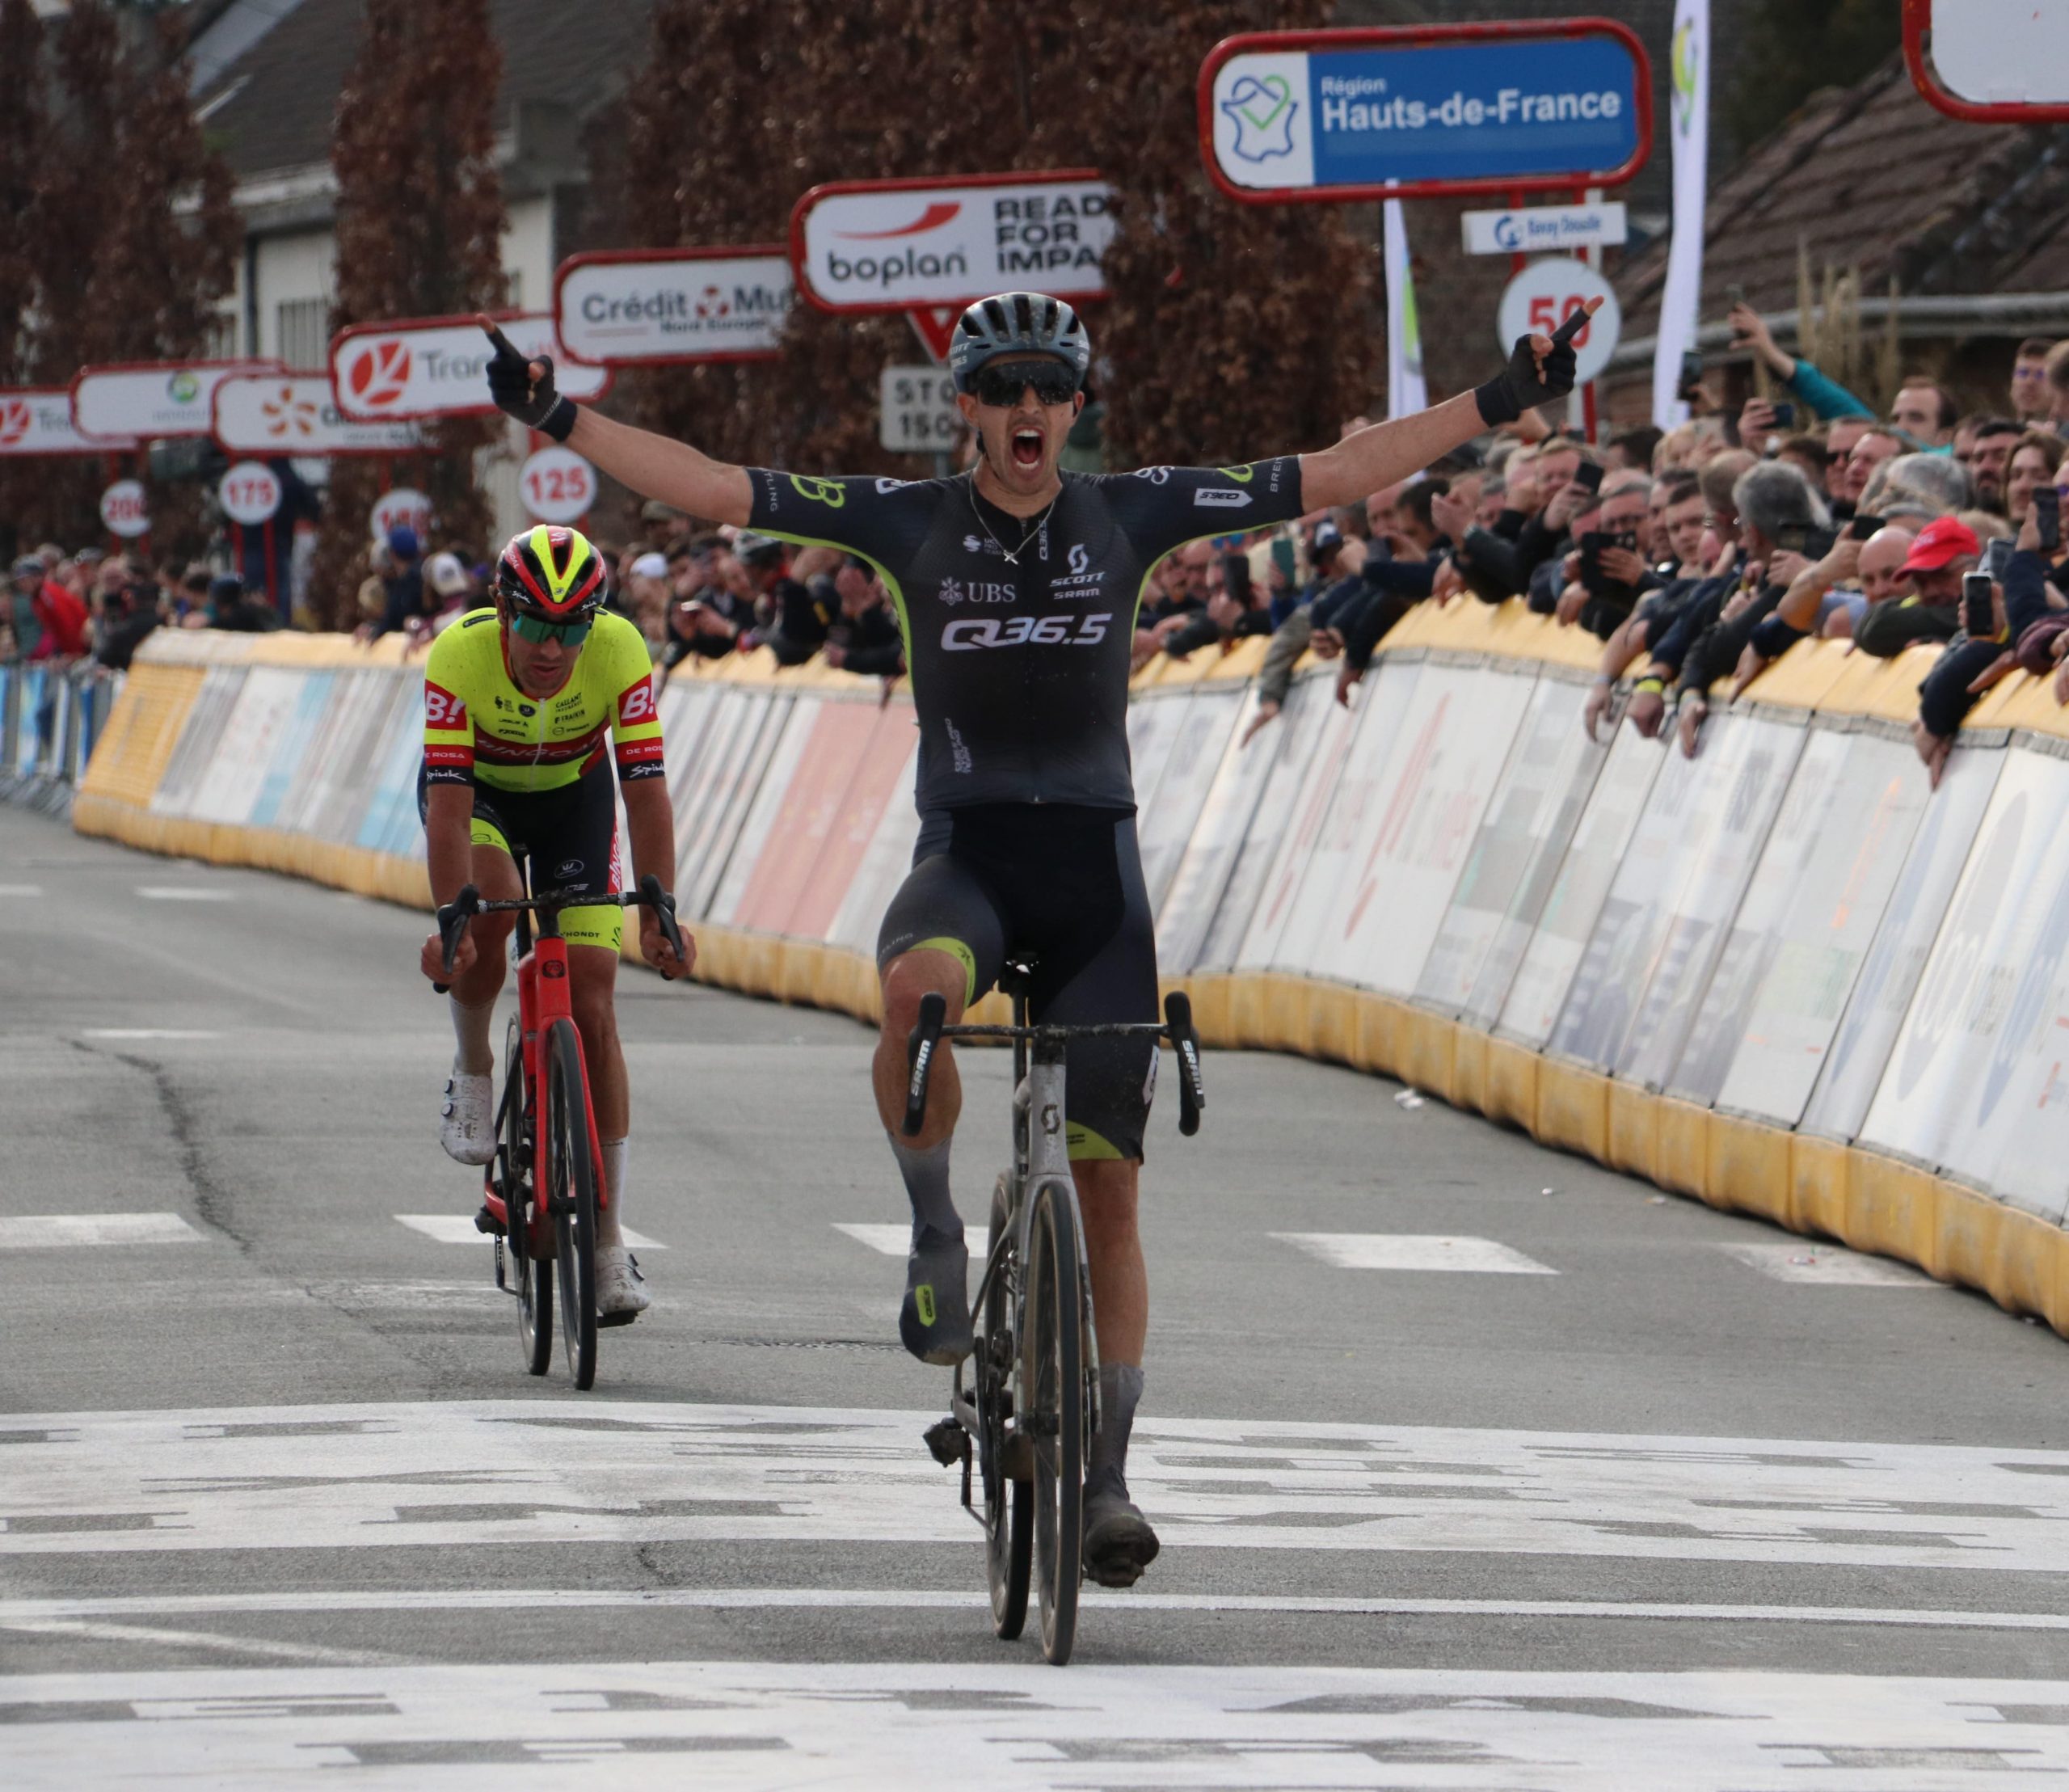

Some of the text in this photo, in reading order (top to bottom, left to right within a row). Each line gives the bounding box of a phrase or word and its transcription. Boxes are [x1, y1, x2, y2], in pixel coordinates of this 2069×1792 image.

[1321, 75, 1387, 99] Région
[1321, 88, 1621, 133] Hauts-de-France
[995, 222, 1079, 245] FOR
[827, 246, 967, 287] boplan
[581, 289, 687, 323] Crédit
[1528, 293, 1591, 351] 50
[894, 377, 957, 405] STO
[228, 479, 272, 506] 175
[528, 466, 588, 503] 125
[967, 581, 1017, 603] UBS
[1050, 571, 1106, 587] SCOTT
[1054, 588, 1100, 600] SRAM
[941, 613, 1113, 651] Q36.5
[426, 689, 466, 723] B!
[621, 673, 655, 719] B!
[626, 748, 641, 756] DE
[911, 1039, 931, 1096] SRAM
[1182, 1040, 1203, 1094] SRAM
